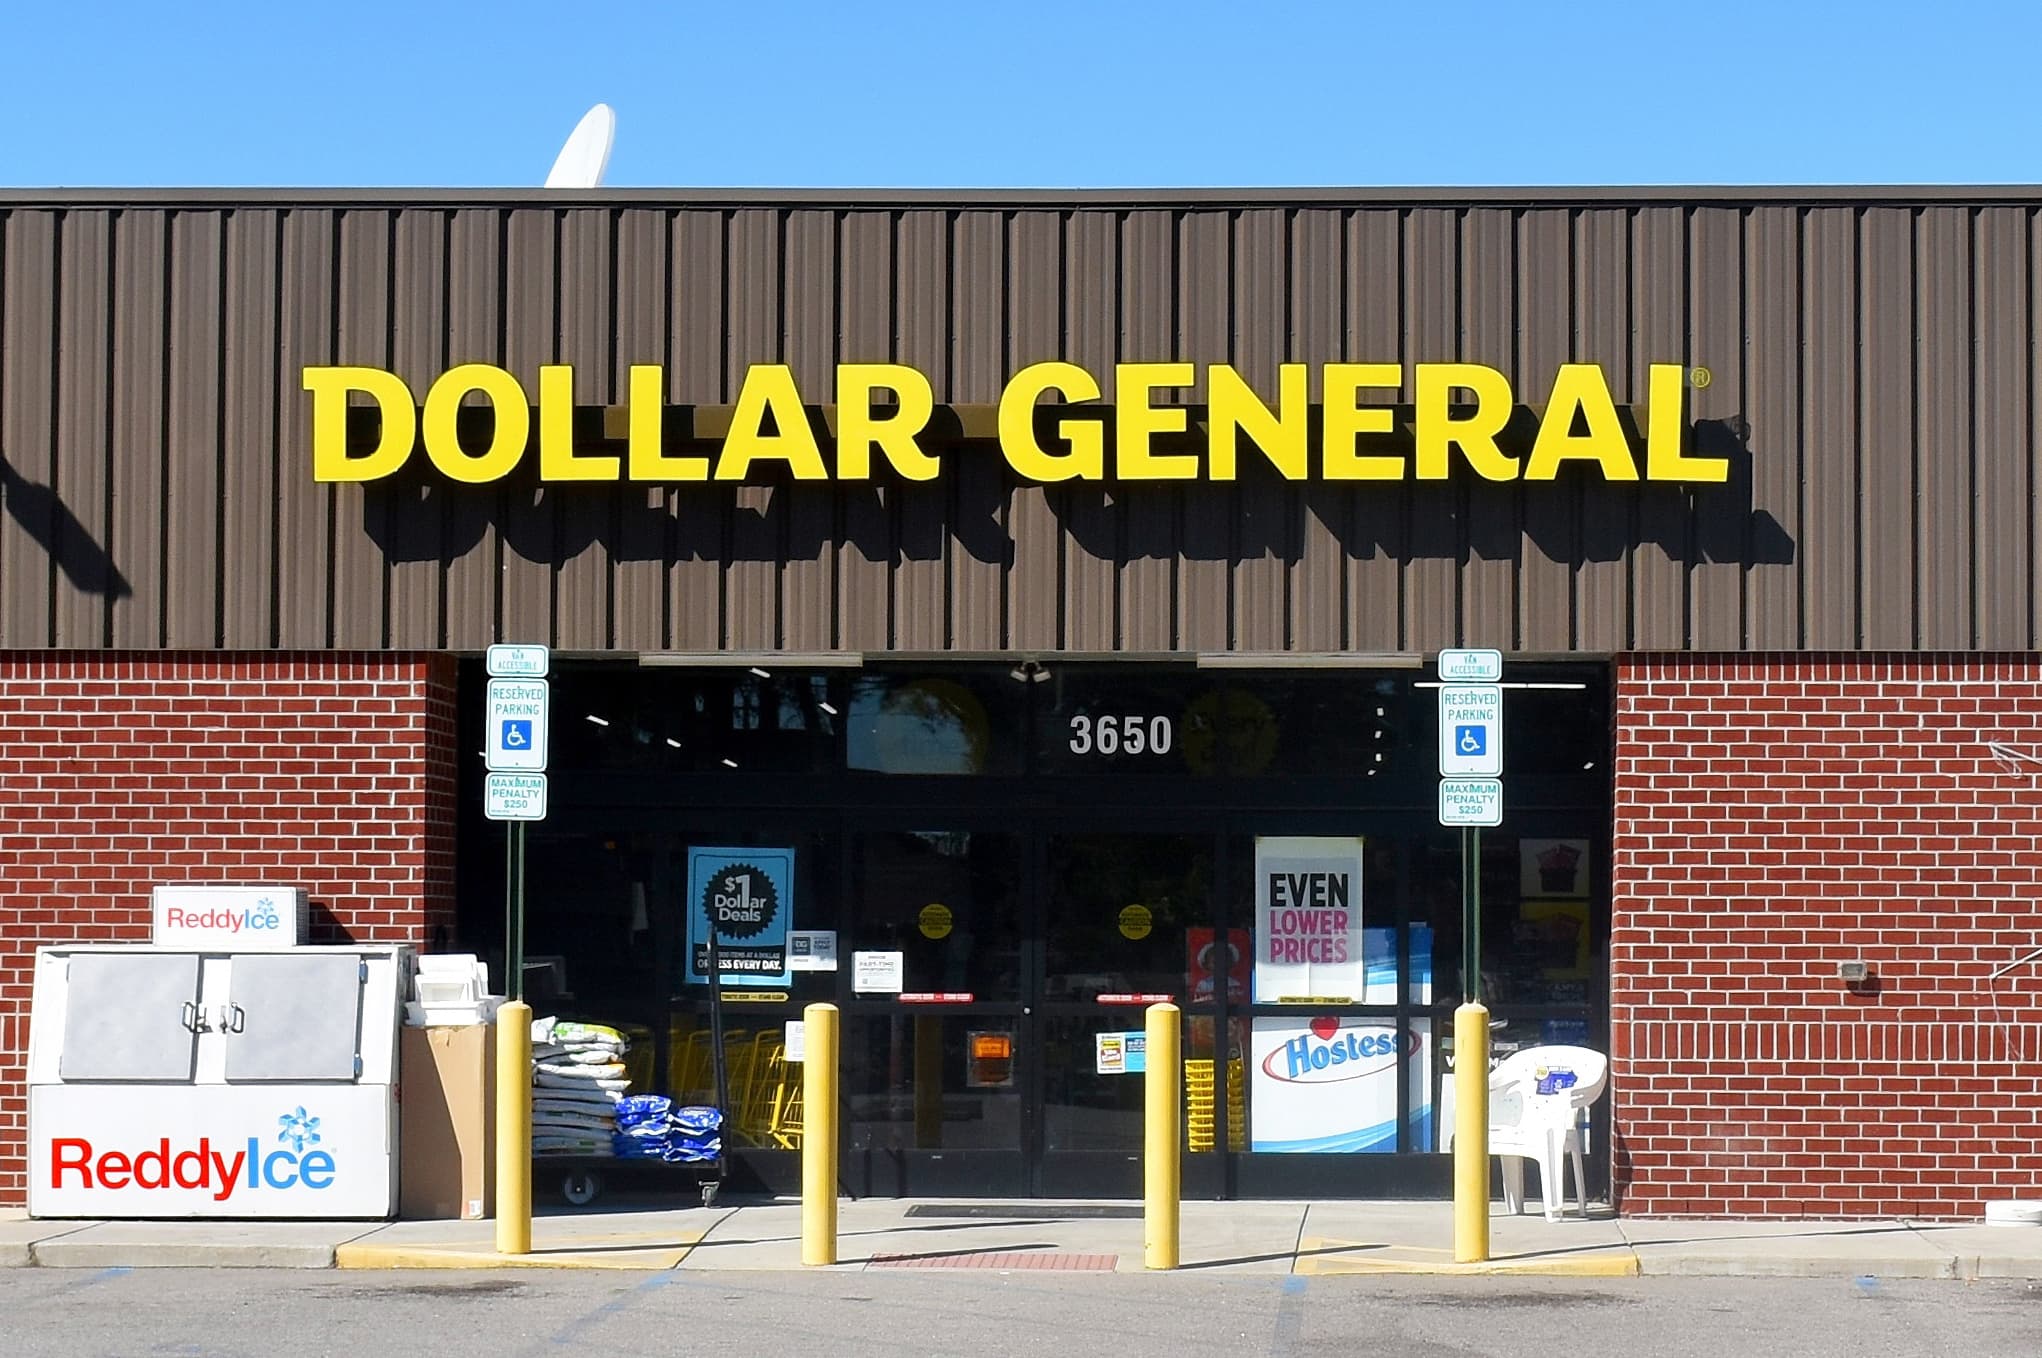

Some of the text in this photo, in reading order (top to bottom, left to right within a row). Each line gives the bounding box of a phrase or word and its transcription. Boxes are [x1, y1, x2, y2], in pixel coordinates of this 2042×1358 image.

[303, 362, 1729, 483] DOLLAR GENERAL
[493, 688, 544, 700] RESERVED
[1445, 693, 1497, 705] RESERVED
[495, 703, 540, 715] PARKING
[1448, 709, 1494, 720] PARKING
[1069, 715, 1172, 754] 3650
[491, 778, 541, 788] MAXIMUM
[1445, 784, 1497, 793] MAXIMUM
[492, 789, 540, 798] PENALTY
[1446, 795, 1495, 804] PENALTY
[504, 800, 528, 809] $250
[1458, 805, 1483, 814] $250
[725, 874, 750, 909] $1
[1269, 873, 1349, 907] EVEN
[167, 907, 280, 934] ReddyIce
[718, 909, 761, 922] Deals
[1269, 910, 1348, 935] LOWER
[1269, 937, 1348, 964] PRICES
[718, 960, 732, 969] ESS
[733, 960, 760, 970] EVERY
[762, 960, 782, 970] DAY.
[51, 1137, 336, 1201] ReddyIce
